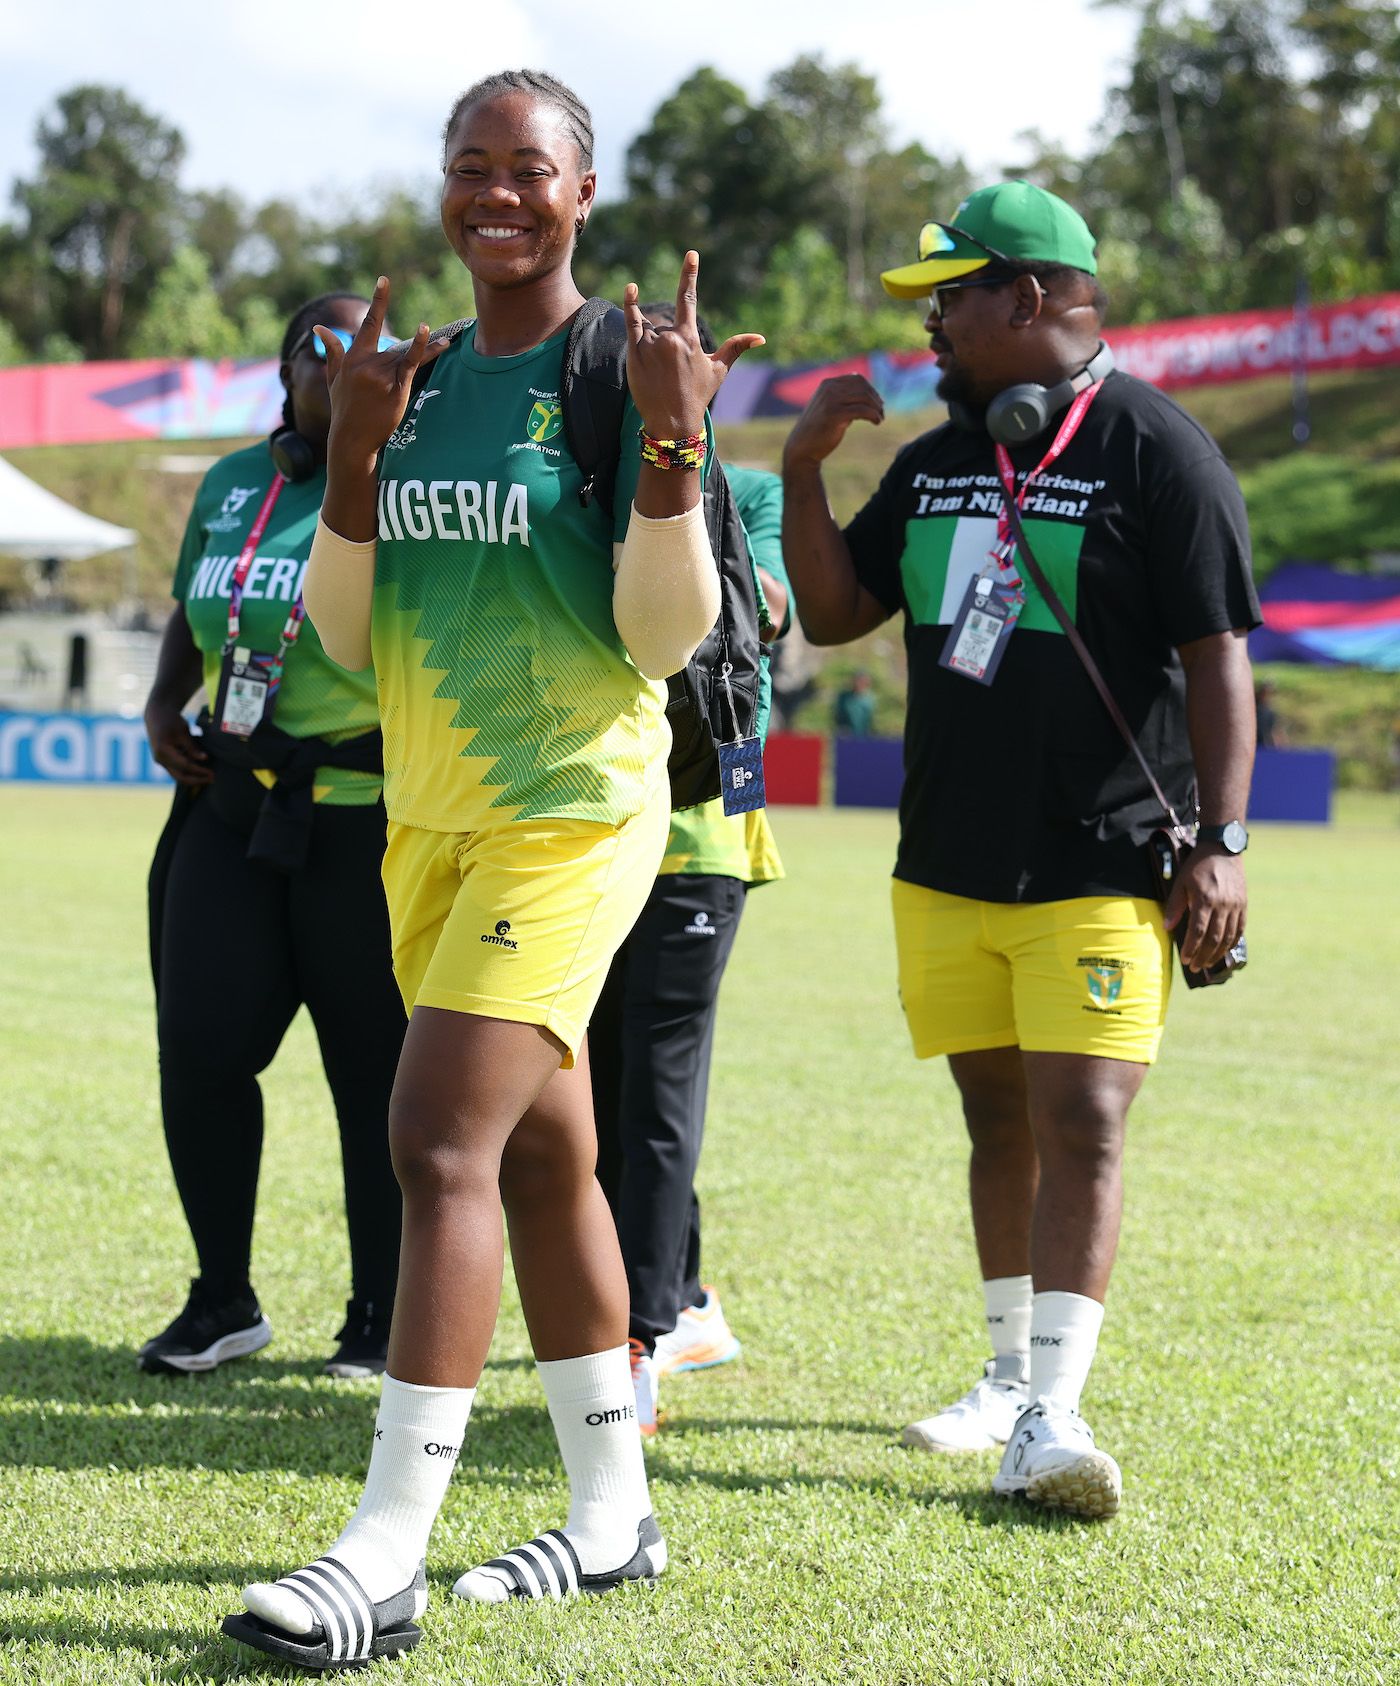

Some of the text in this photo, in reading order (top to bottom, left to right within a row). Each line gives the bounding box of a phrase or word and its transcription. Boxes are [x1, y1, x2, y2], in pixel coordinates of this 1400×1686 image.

[975, 474, 1002, 487] on
[916, 491, 1089, 518] I am Nirian!
[189, 556, 309, 602] NIGERI
[480, 934, 518, 949] omtex
[585, 1405, 634, 1426] omte
